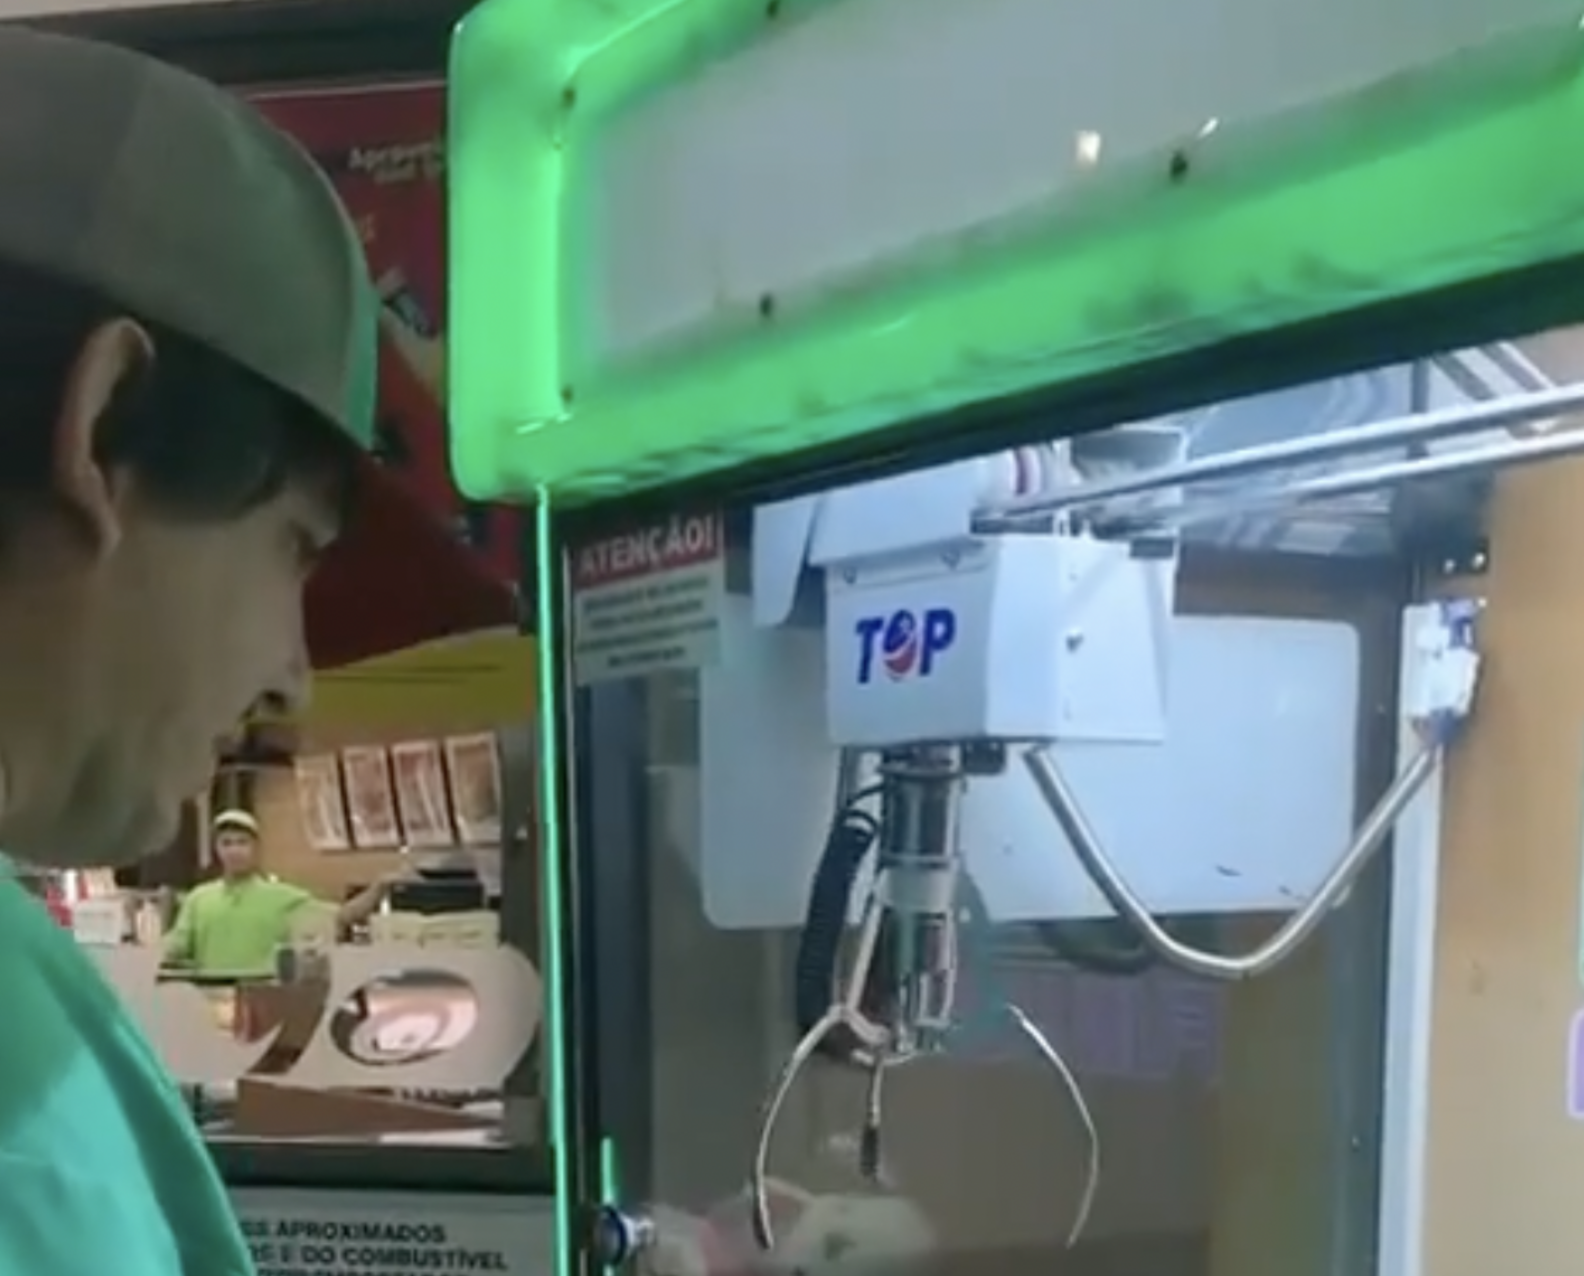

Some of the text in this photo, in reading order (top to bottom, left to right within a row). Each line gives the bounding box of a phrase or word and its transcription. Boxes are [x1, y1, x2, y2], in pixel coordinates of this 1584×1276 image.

[856, 608, 956, 684] TOP
[276, 1221, 447, 1243] APROXIMADOS
[301, 1246, 336, 1266] DO
[341, 1247, 509, 1271] COMBUSTÍVEL
